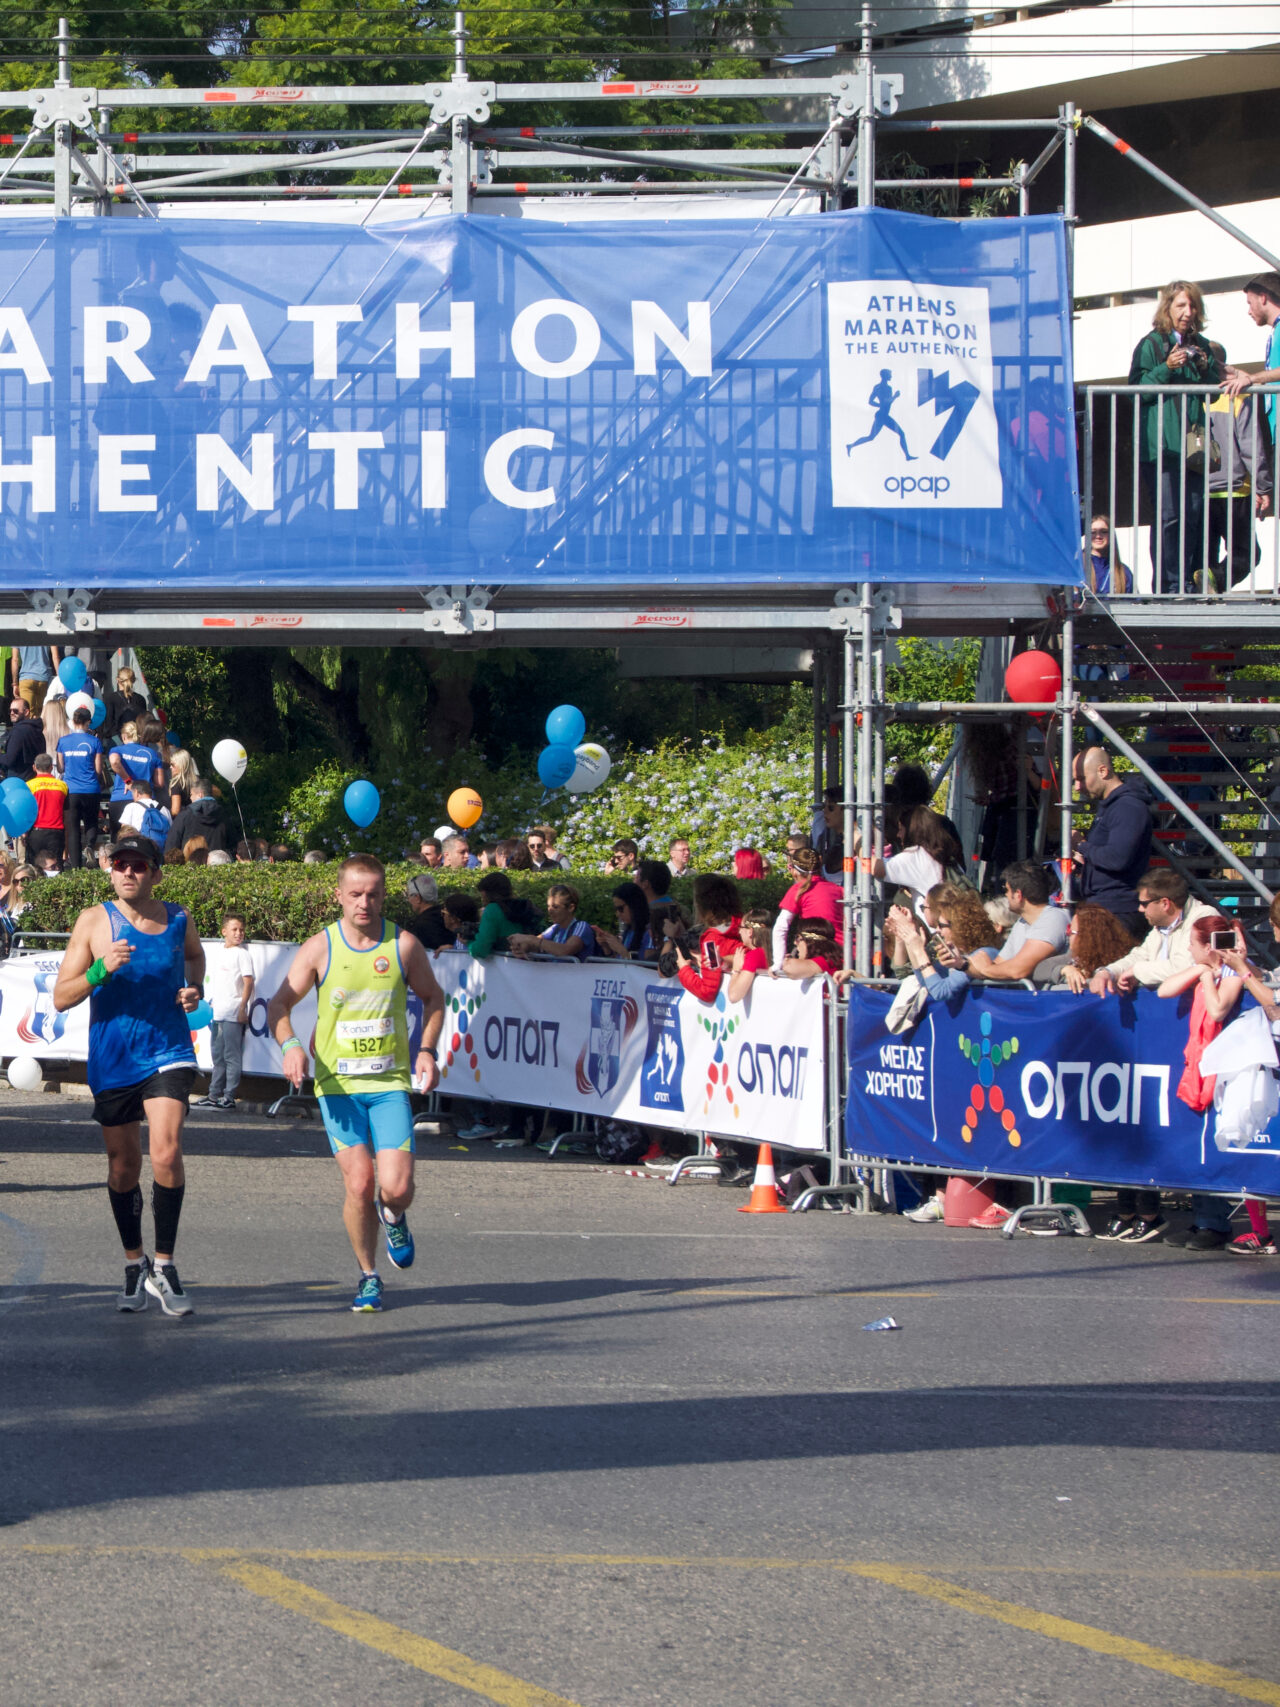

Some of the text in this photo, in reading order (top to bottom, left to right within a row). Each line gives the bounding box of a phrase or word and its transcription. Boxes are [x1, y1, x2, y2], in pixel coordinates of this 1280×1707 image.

[866, 294, 957, 317] ATHENS
[844, 319, 978, 341] MARATHON
[844, 341, 979, 359] THE AUTHENTIC
[883, 475, 951, 500] opap
[592, 979, 627, 998] ΣΕΓΑΣ
[351, 1037, 384, 1053] 1527
[880, 1044, 926, 1071] ΜΕΓΑΣ
[865, 1070, 926, 1101] ΧΟΡΗΓΟΣ
